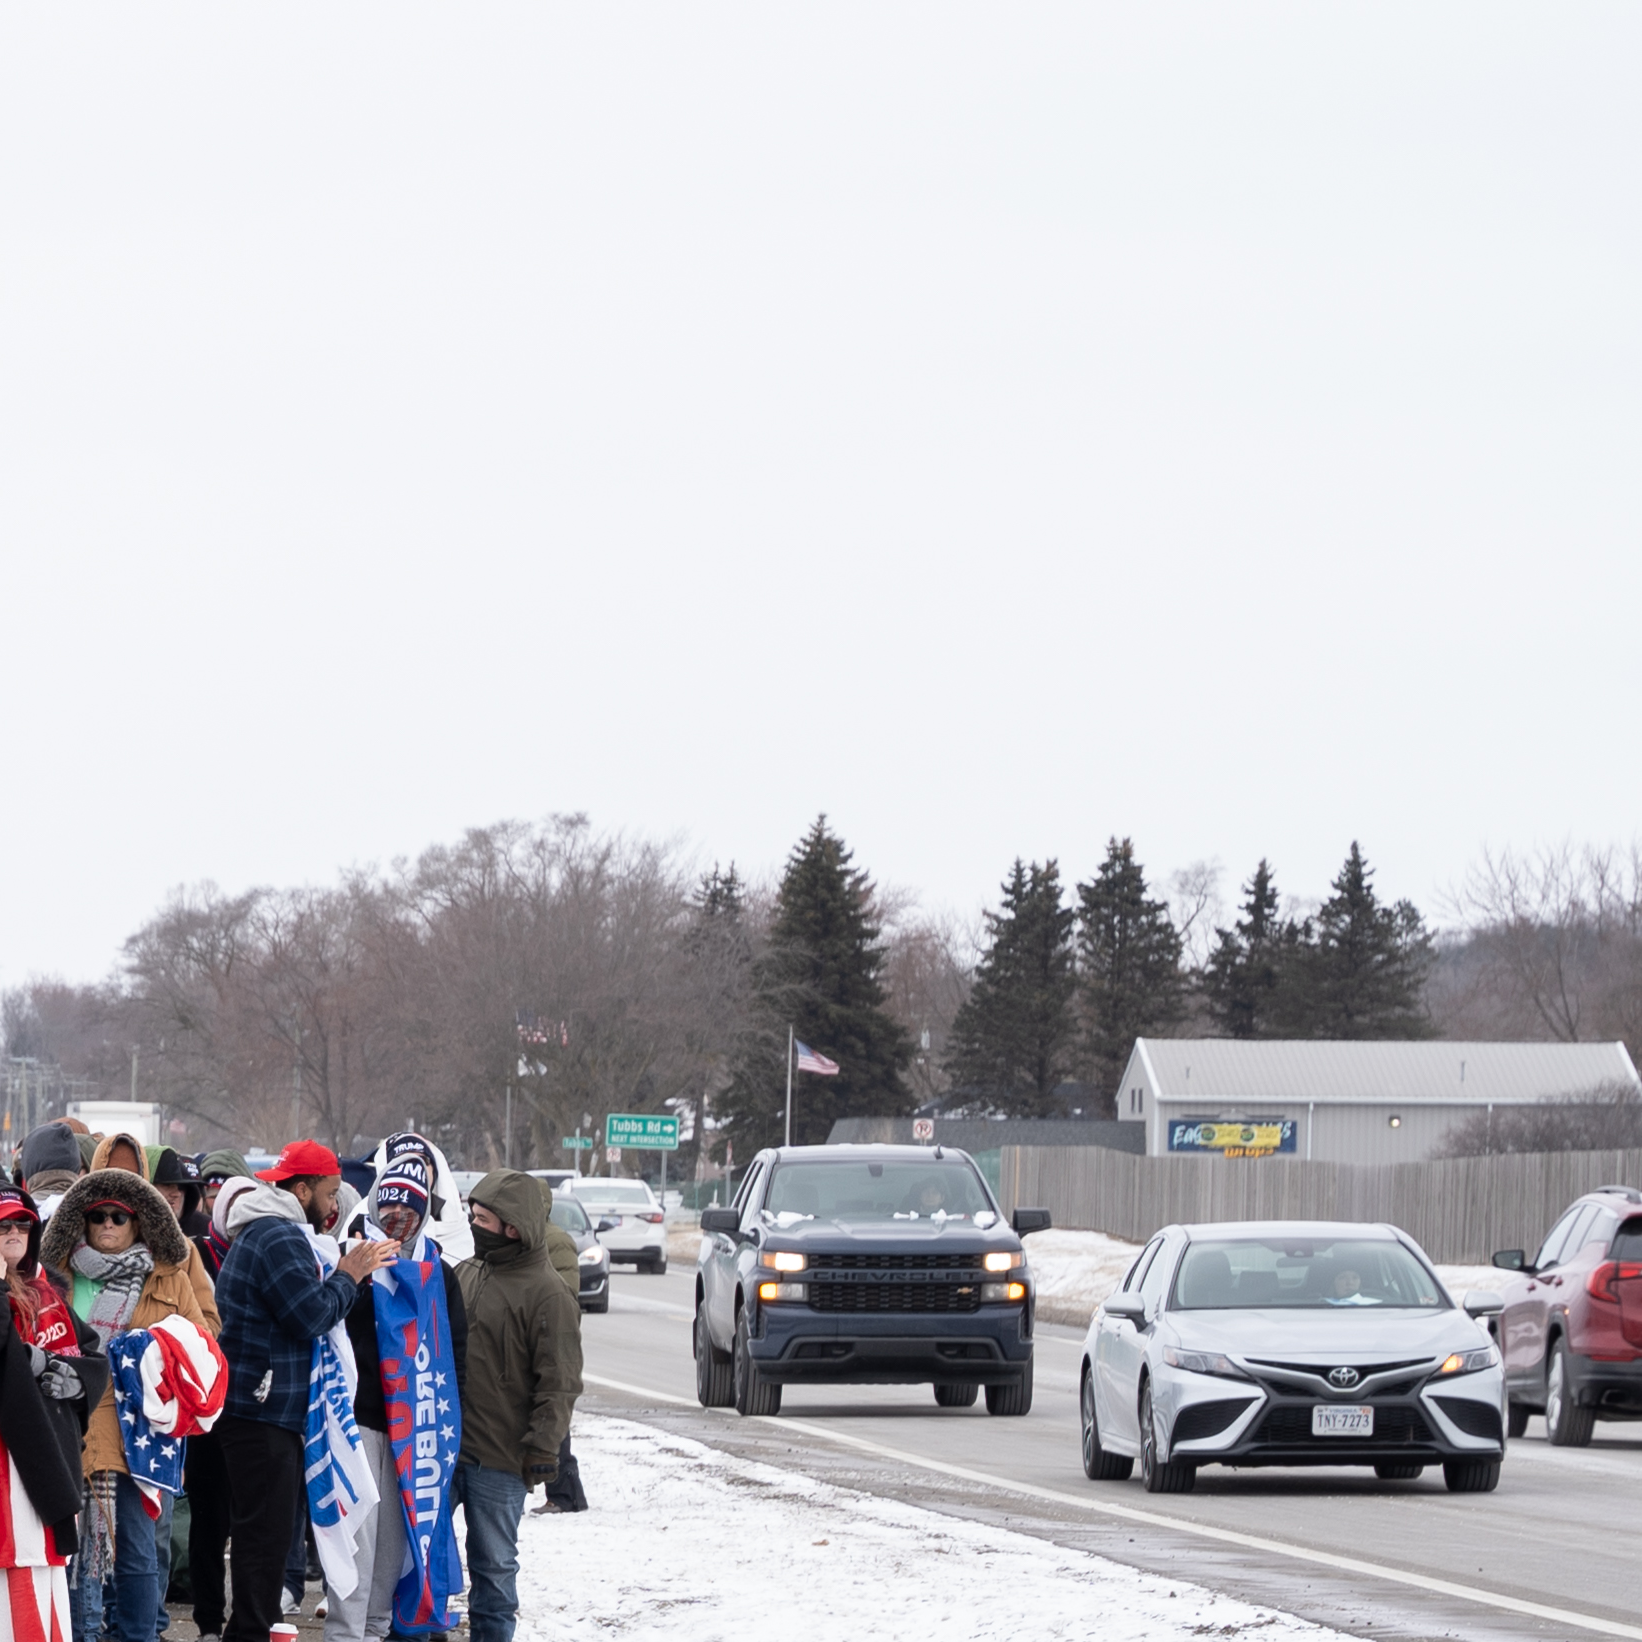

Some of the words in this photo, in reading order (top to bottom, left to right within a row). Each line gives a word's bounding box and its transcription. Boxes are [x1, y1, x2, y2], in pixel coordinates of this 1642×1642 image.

[612, 1120, 643, 1133] Tubbs
[647, 1121, 661, 1133] Rd
[611, 1133, 627, 1142] NEXT
[630, 1134, 675, 1145] INTERSECTION
[394, 1142, 424, 1154] TRUMP
[813, 1271, 979, 1281] CHEVROLET
[1317, 1414, 1370, 1428] TNY-7273
